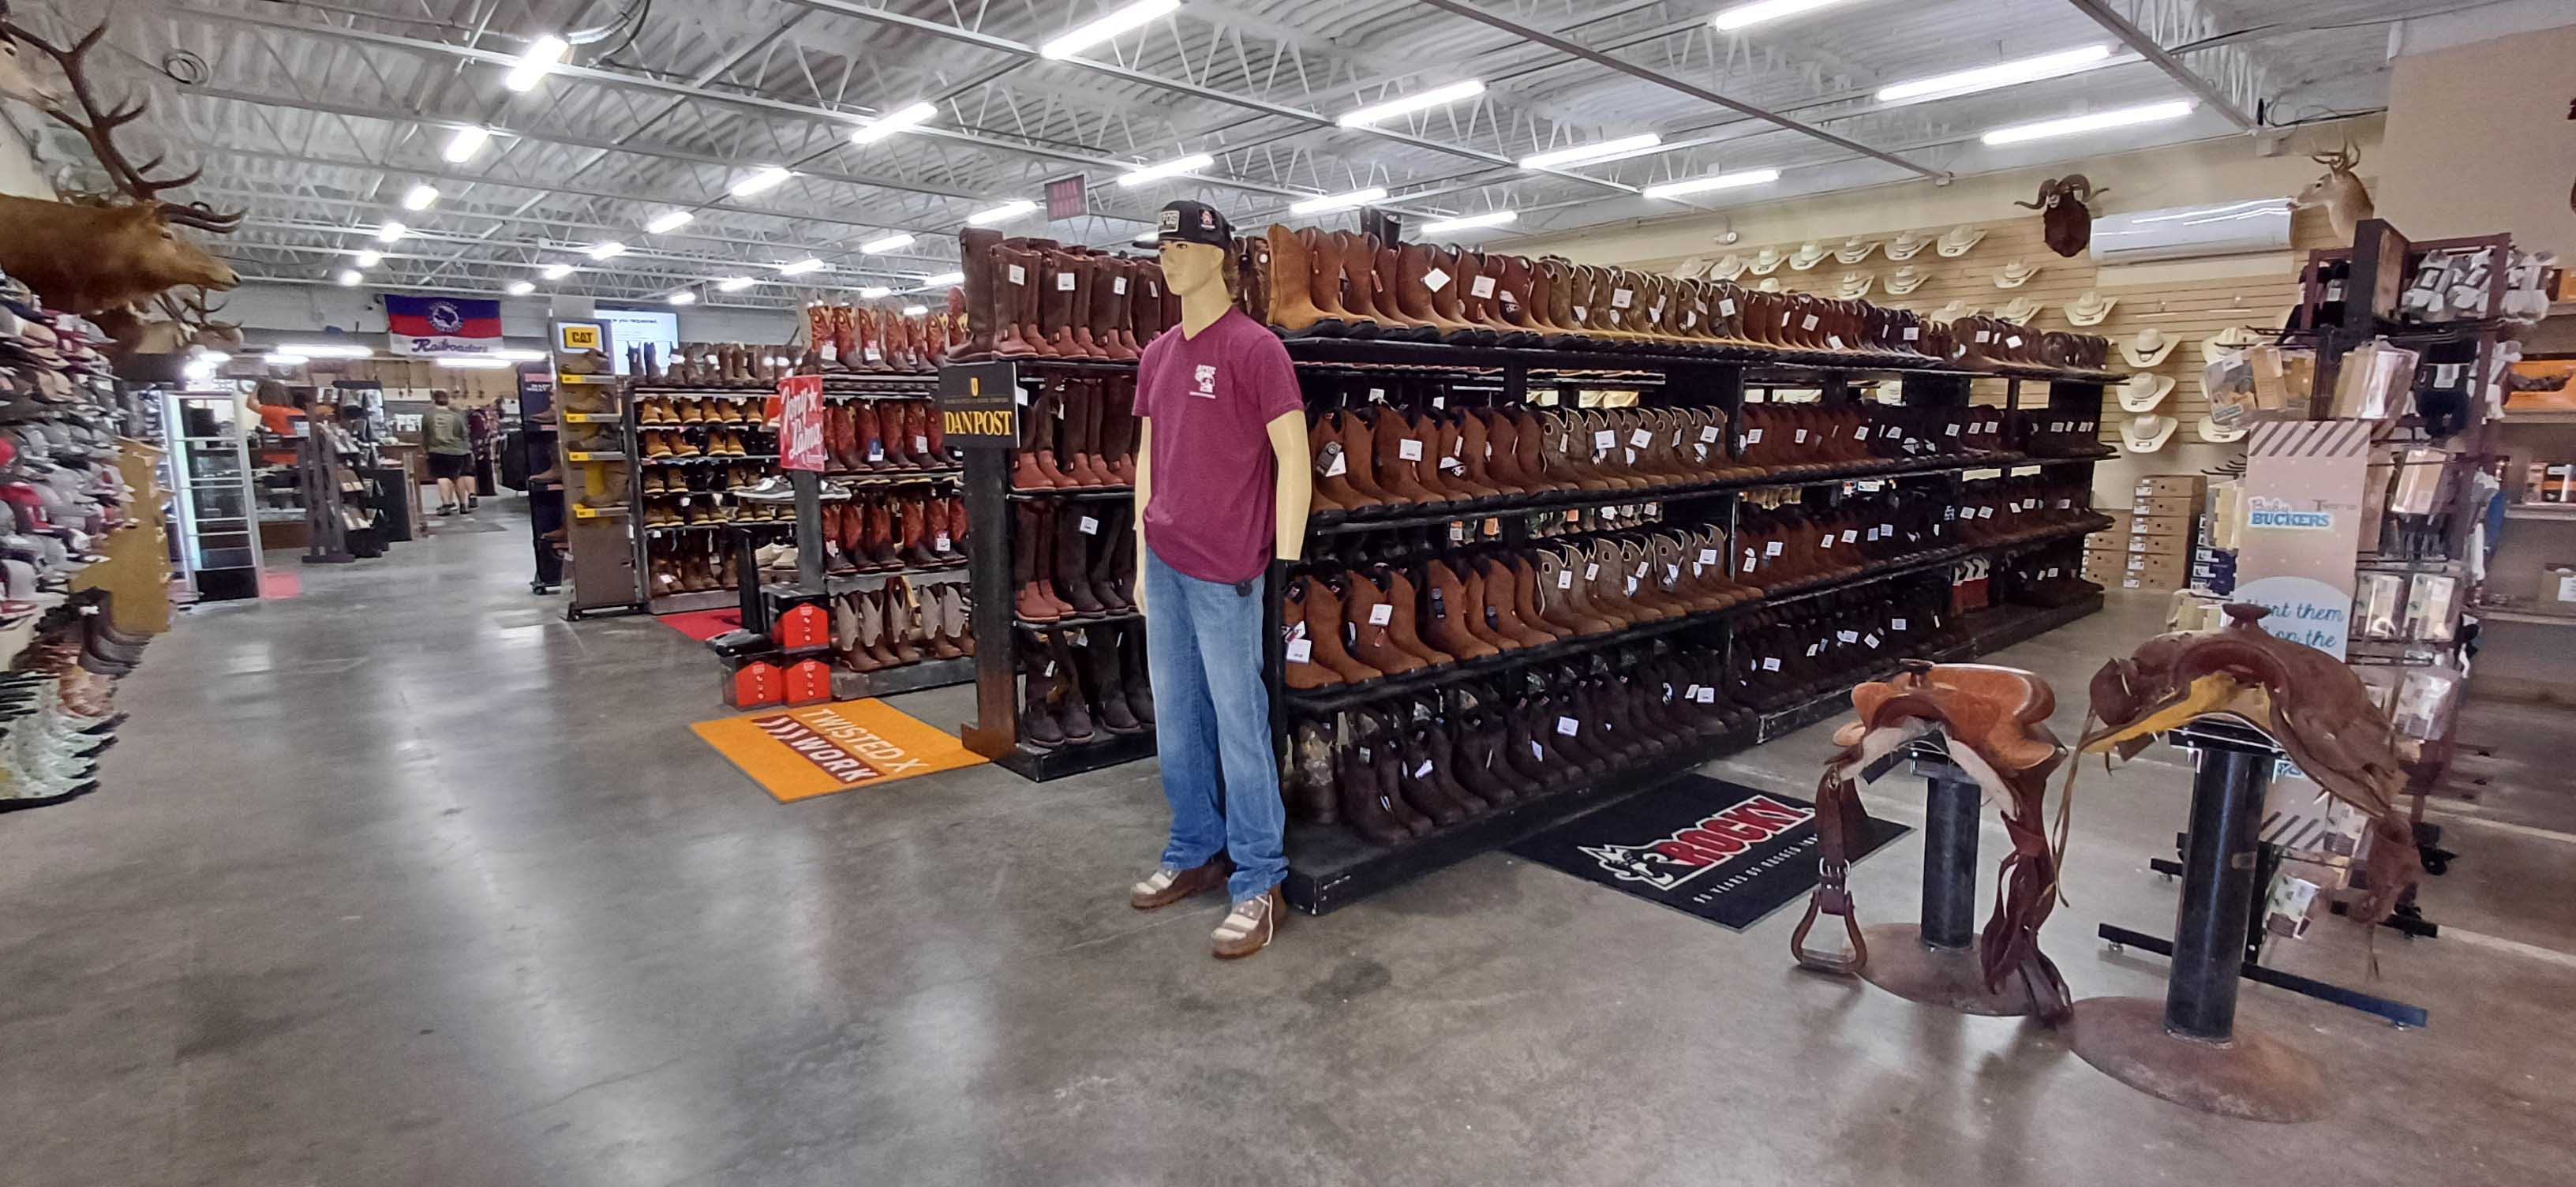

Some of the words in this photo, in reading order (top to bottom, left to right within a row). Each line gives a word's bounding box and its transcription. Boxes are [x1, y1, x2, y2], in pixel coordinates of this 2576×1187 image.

[411, 338, 489, 353] Railroaders
[571, 331, 593, 344] CAT
[777, 377, 808, 435] Tony
[789, 418, 824, 460] Lama
[2252, 512, 2331, 527] BUCKERS
[2297, 602, 2344, 622] them
[2305, 629, 2337, 647] the
[801, 708, 906, 760] TWISTED
[883, 757, 930, 773] X
[791, 735, 879, 782] WORK
[1654, 794, 1814, 868] ROCKY
